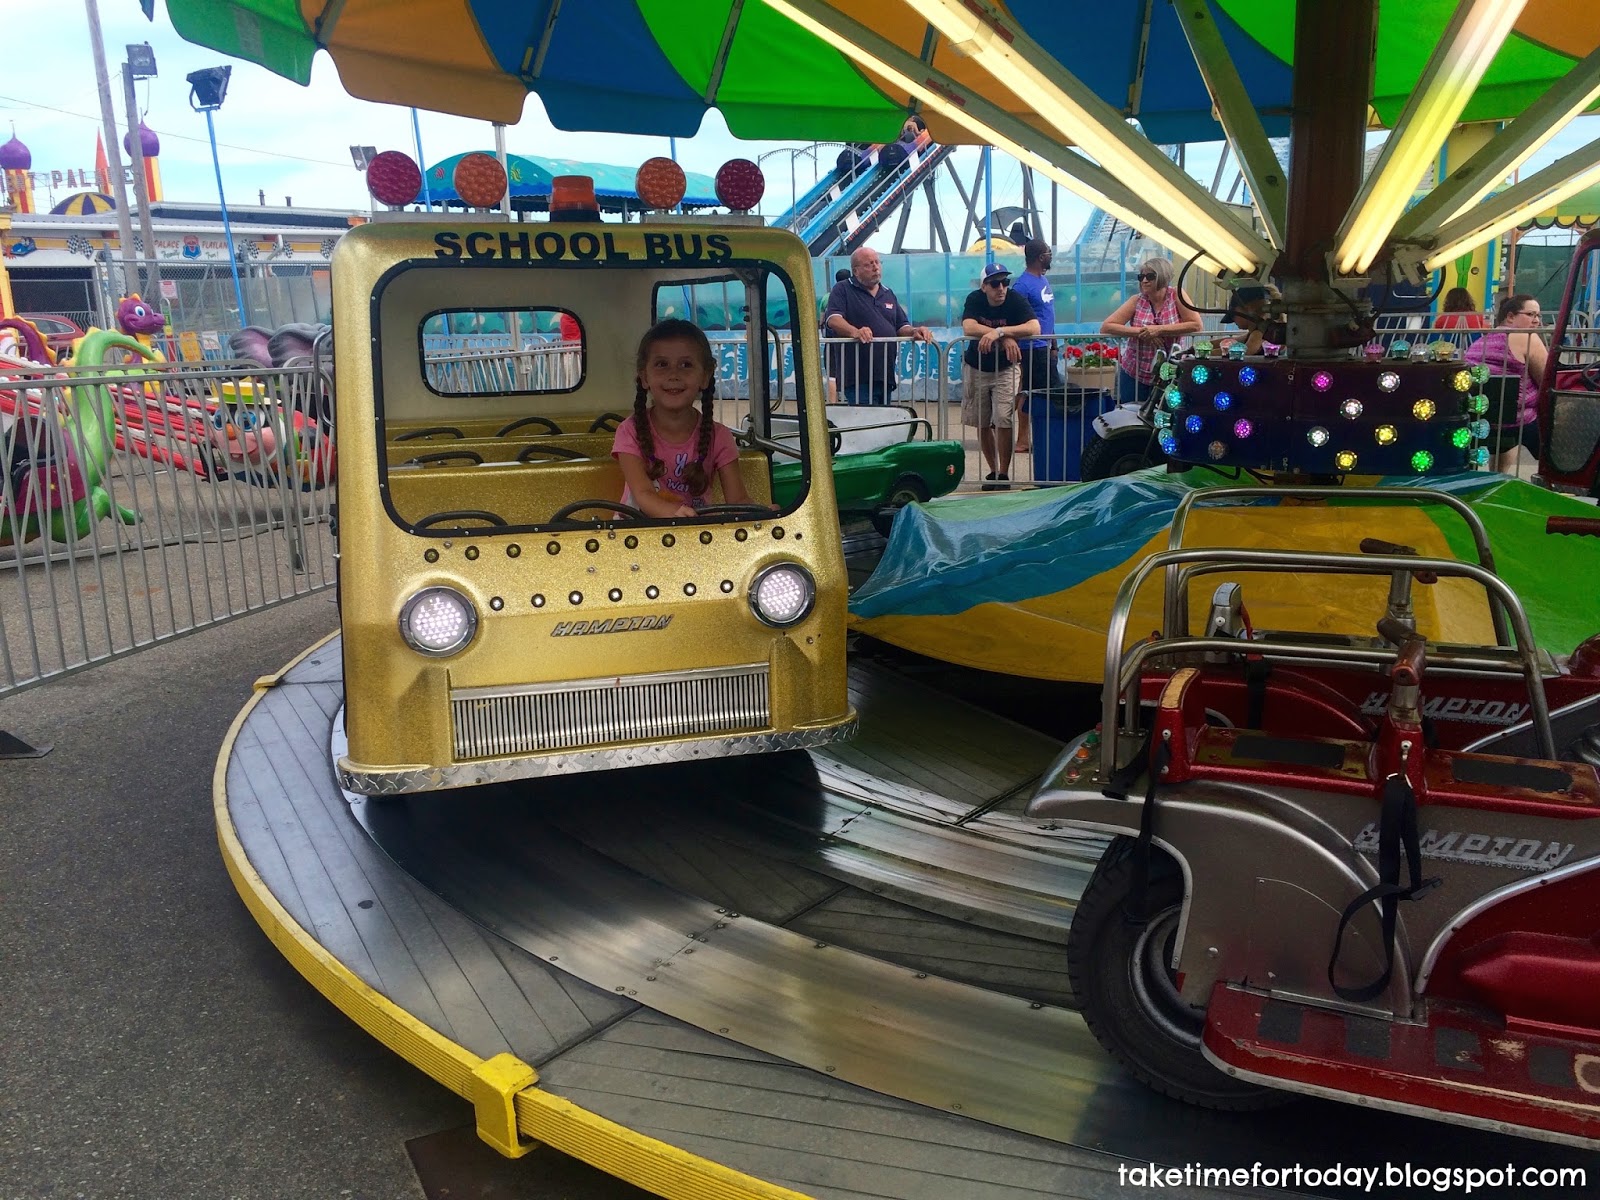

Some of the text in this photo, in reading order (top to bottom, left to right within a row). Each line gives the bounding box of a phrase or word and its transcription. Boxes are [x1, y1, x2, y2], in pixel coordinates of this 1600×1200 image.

[51, 165, 135, 190] PALAE
[202, 240, 229, 250] PLAYLAN
[434, 231, 733, 261] SCHOOL BUS
[550, 614, 676, 638] HAMPTON
[1360, 691, 1531, 722] HMPTON
[1353, 822, 1575, 868] HMPTON
